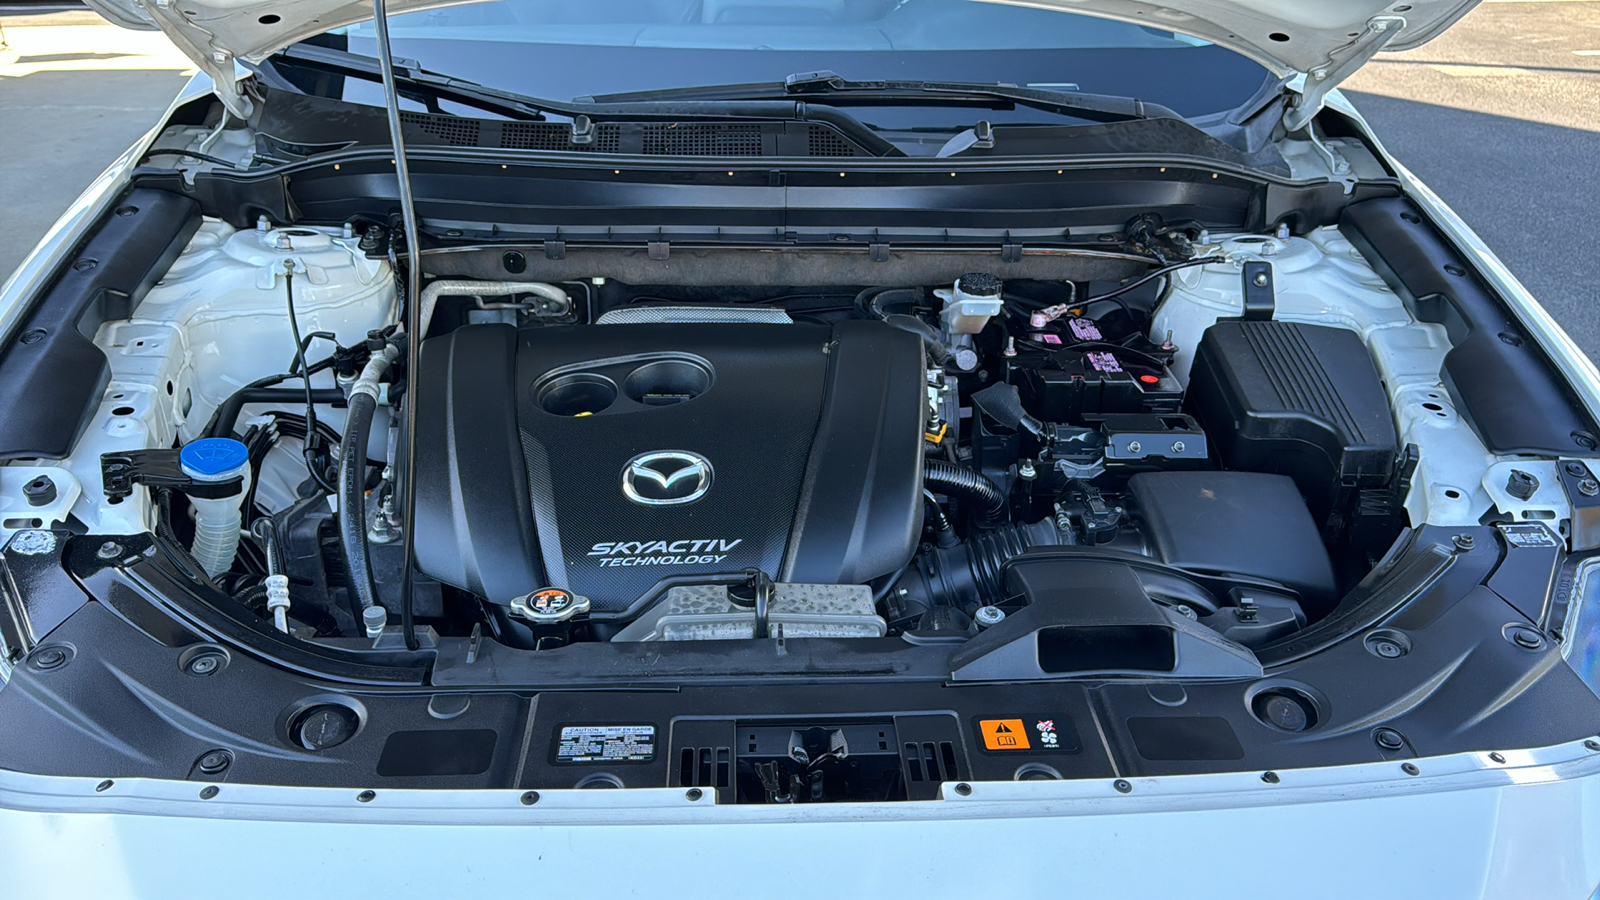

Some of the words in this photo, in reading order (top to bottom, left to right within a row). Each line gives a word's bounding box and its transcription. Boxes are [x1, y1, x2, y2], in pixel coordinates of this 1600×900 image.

[347, 446, 355, 463] PET
[346, 467, 354, 494] EPDM
[586, 539, 743, 556] SKYACTIV
[599, 555, 727, 567] TECHNOLOGY
